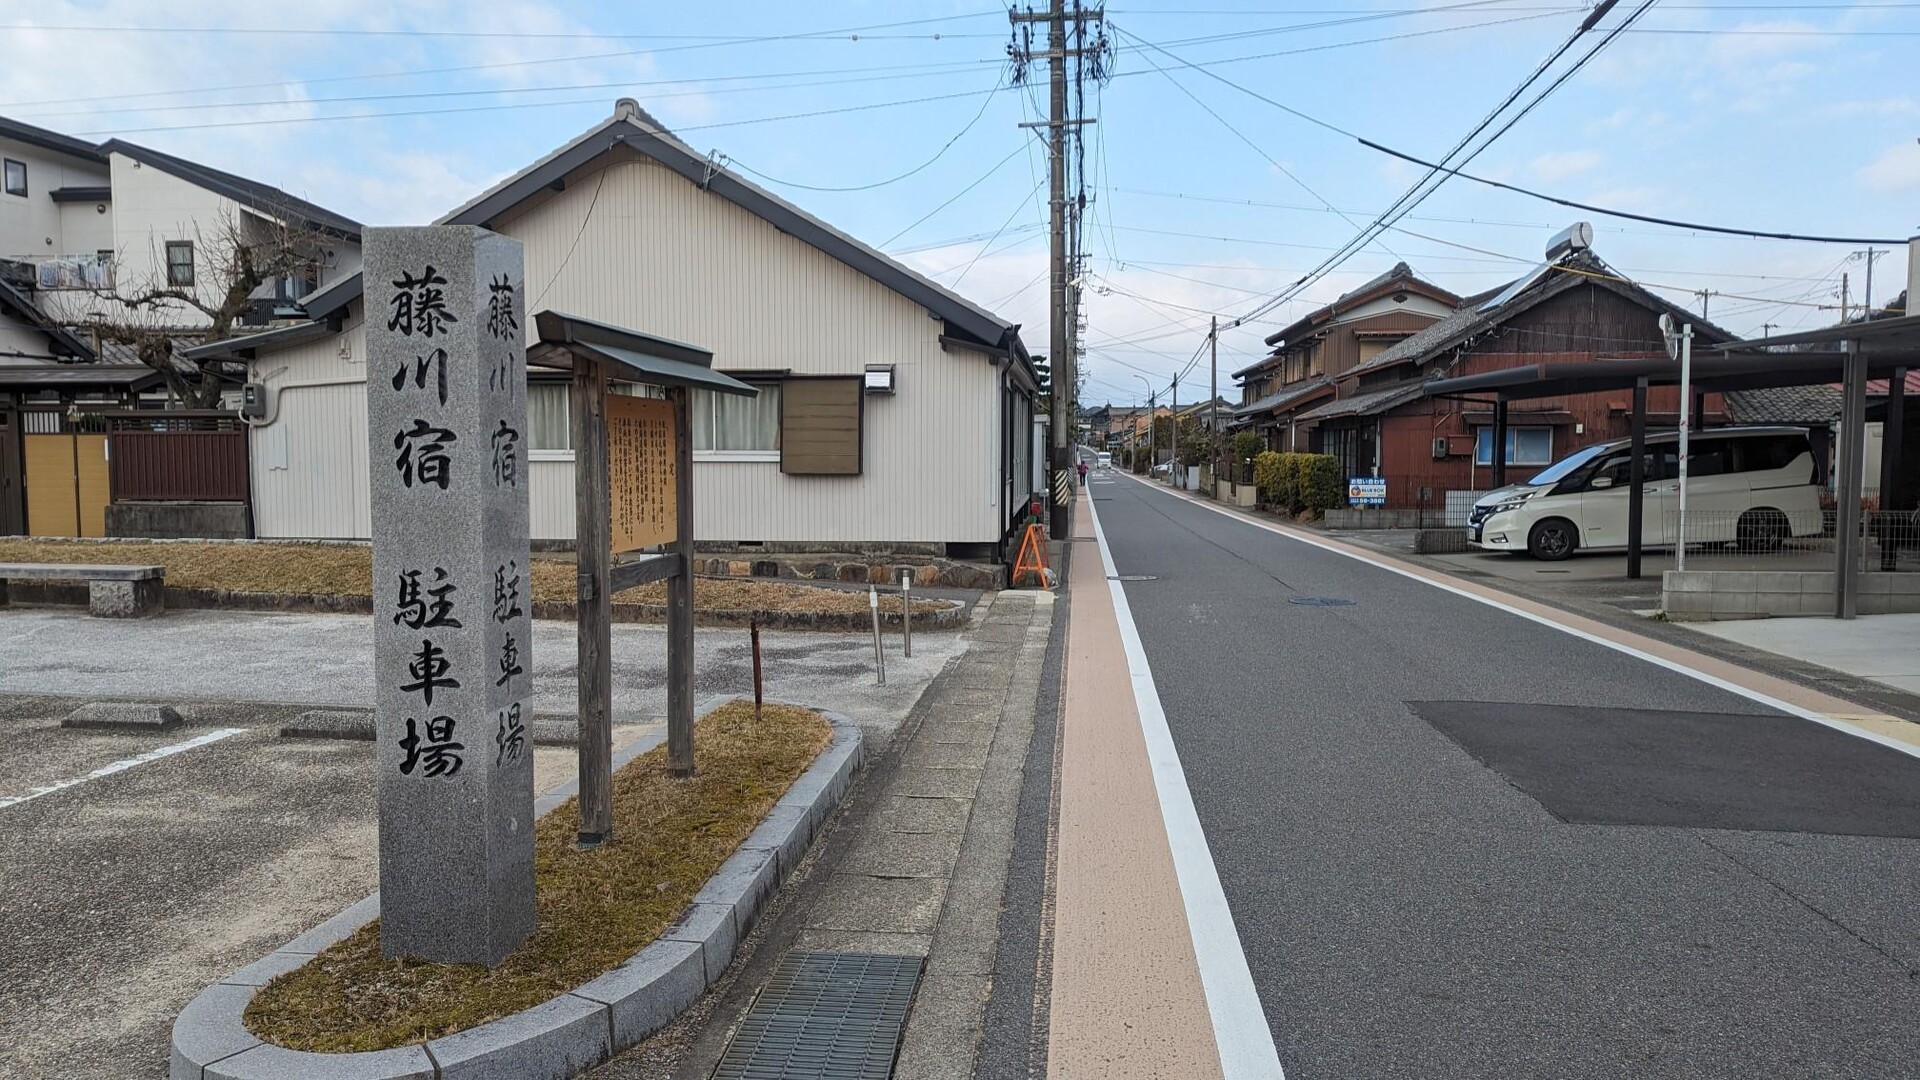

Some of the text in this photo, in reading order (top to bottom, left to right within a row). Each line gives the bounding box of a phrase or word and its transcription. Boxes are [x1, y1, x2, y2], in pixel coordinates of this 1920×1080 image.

[387, 265, 465, 778] 藤川宿 駐車場
[487, 272, 525, 768] 藤川宿 駐車場
